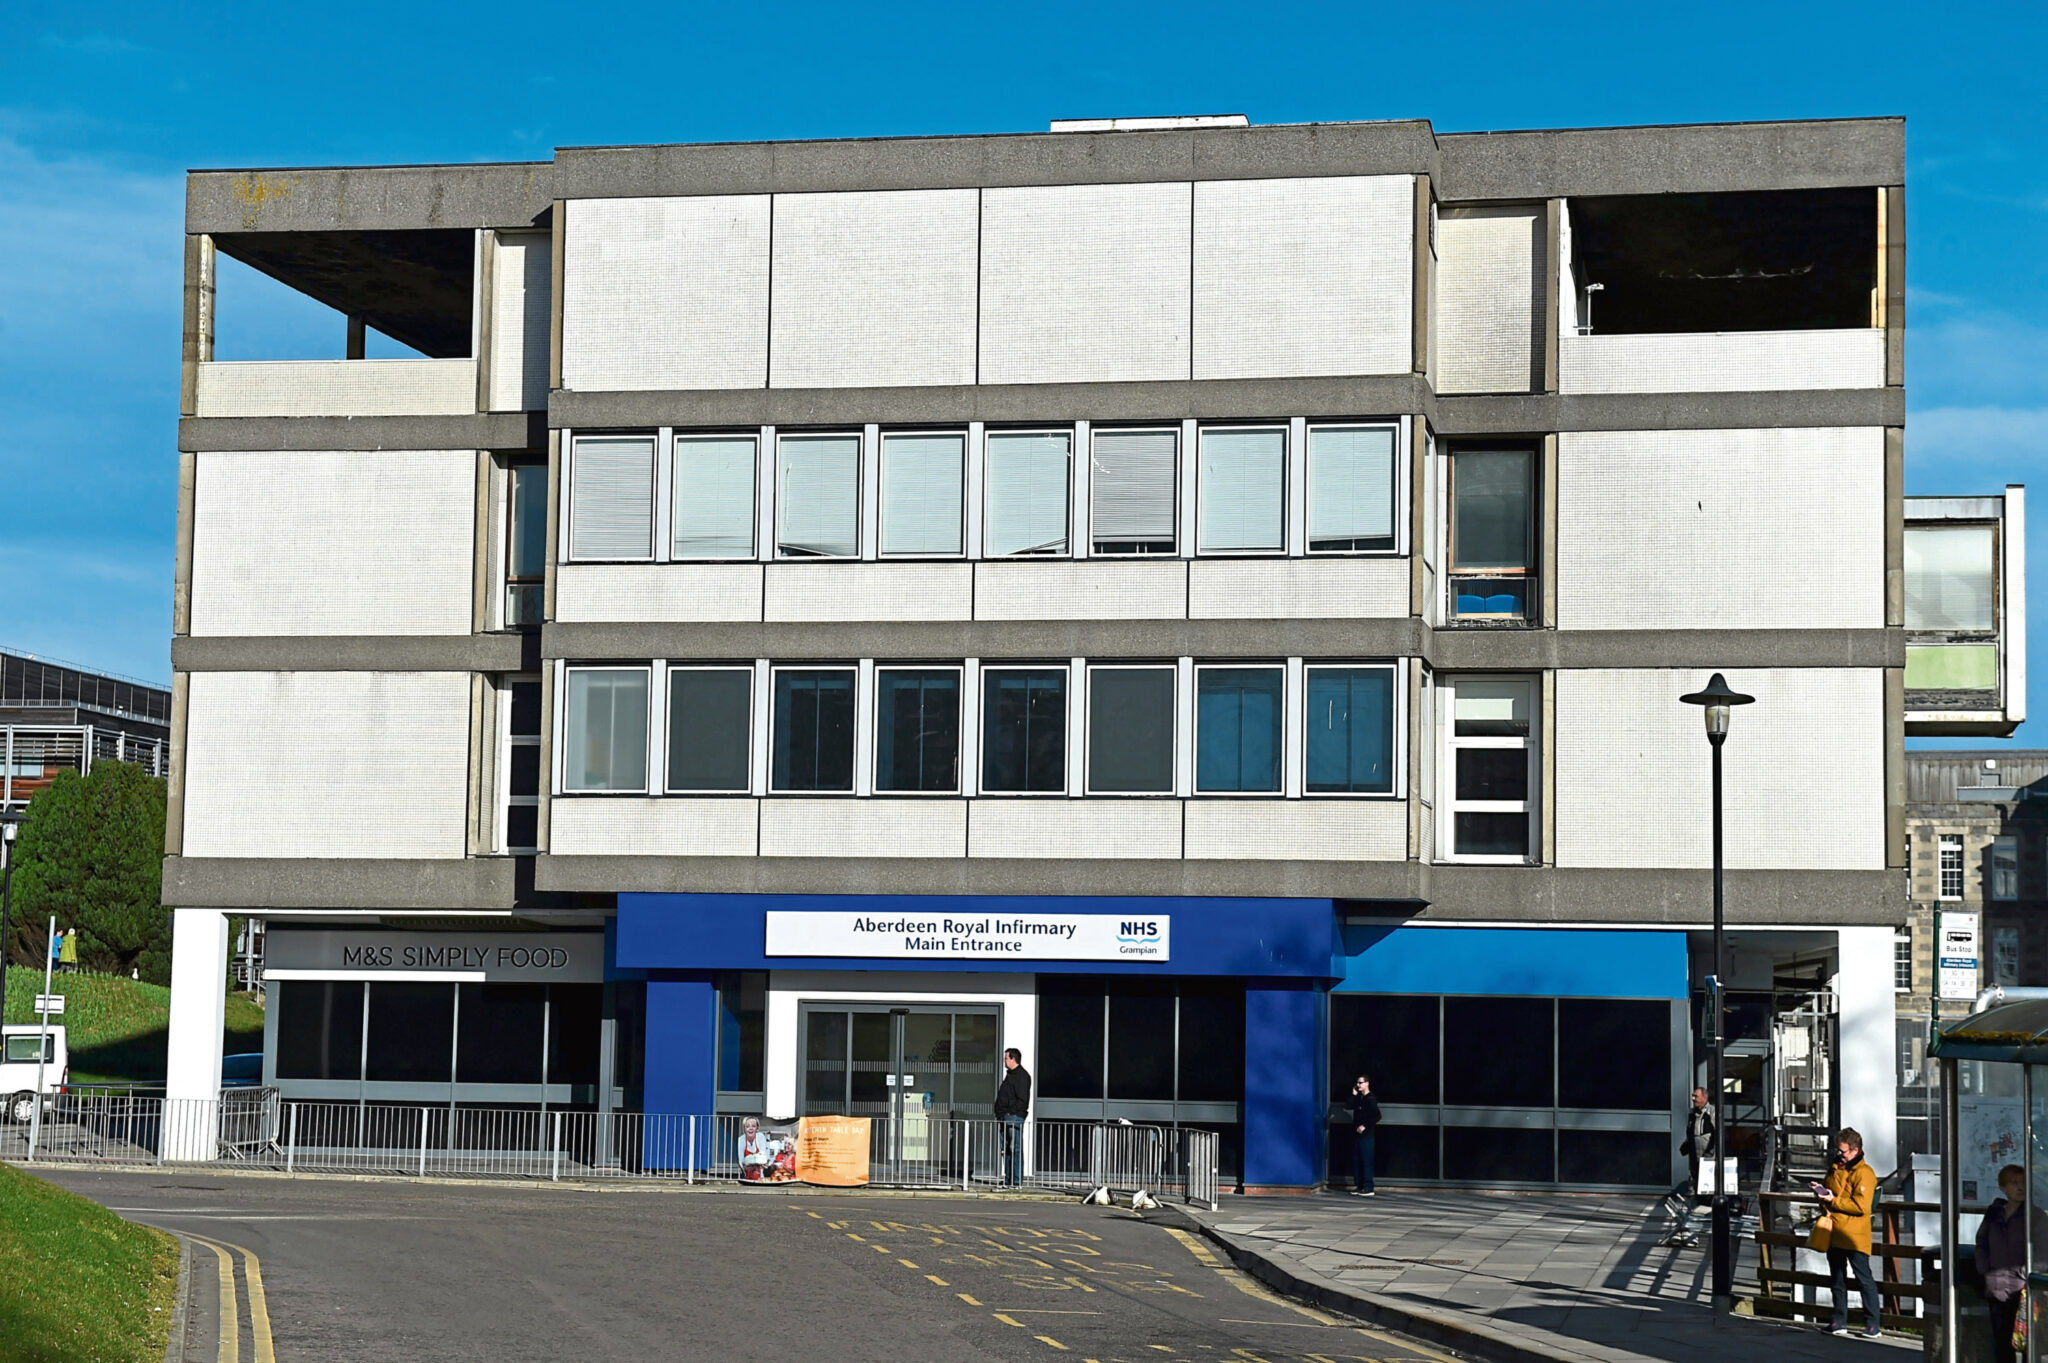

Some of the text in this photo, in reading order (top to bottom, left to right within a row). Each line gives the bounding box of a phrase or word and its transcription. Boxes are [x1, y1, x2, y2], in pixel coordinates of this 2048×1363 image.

[853, 917, 1077, 940] Aberdeen Royal Infirmary
[1120, 921, 1158, 936] NHS
[905, 937, 1022, 951] Main Entrance
[1119, 946, 1157, 955] Grampian
[1946, 945, 1972, 953] Bus Stop
[343, 946, 569, 968] M&S SIMPLY FOOD
[830, 1126, 849, 1135] TABLE
[938, 1253, 1174, 1278] STOP
[1000, 1273, 1205, 1298] BUS
